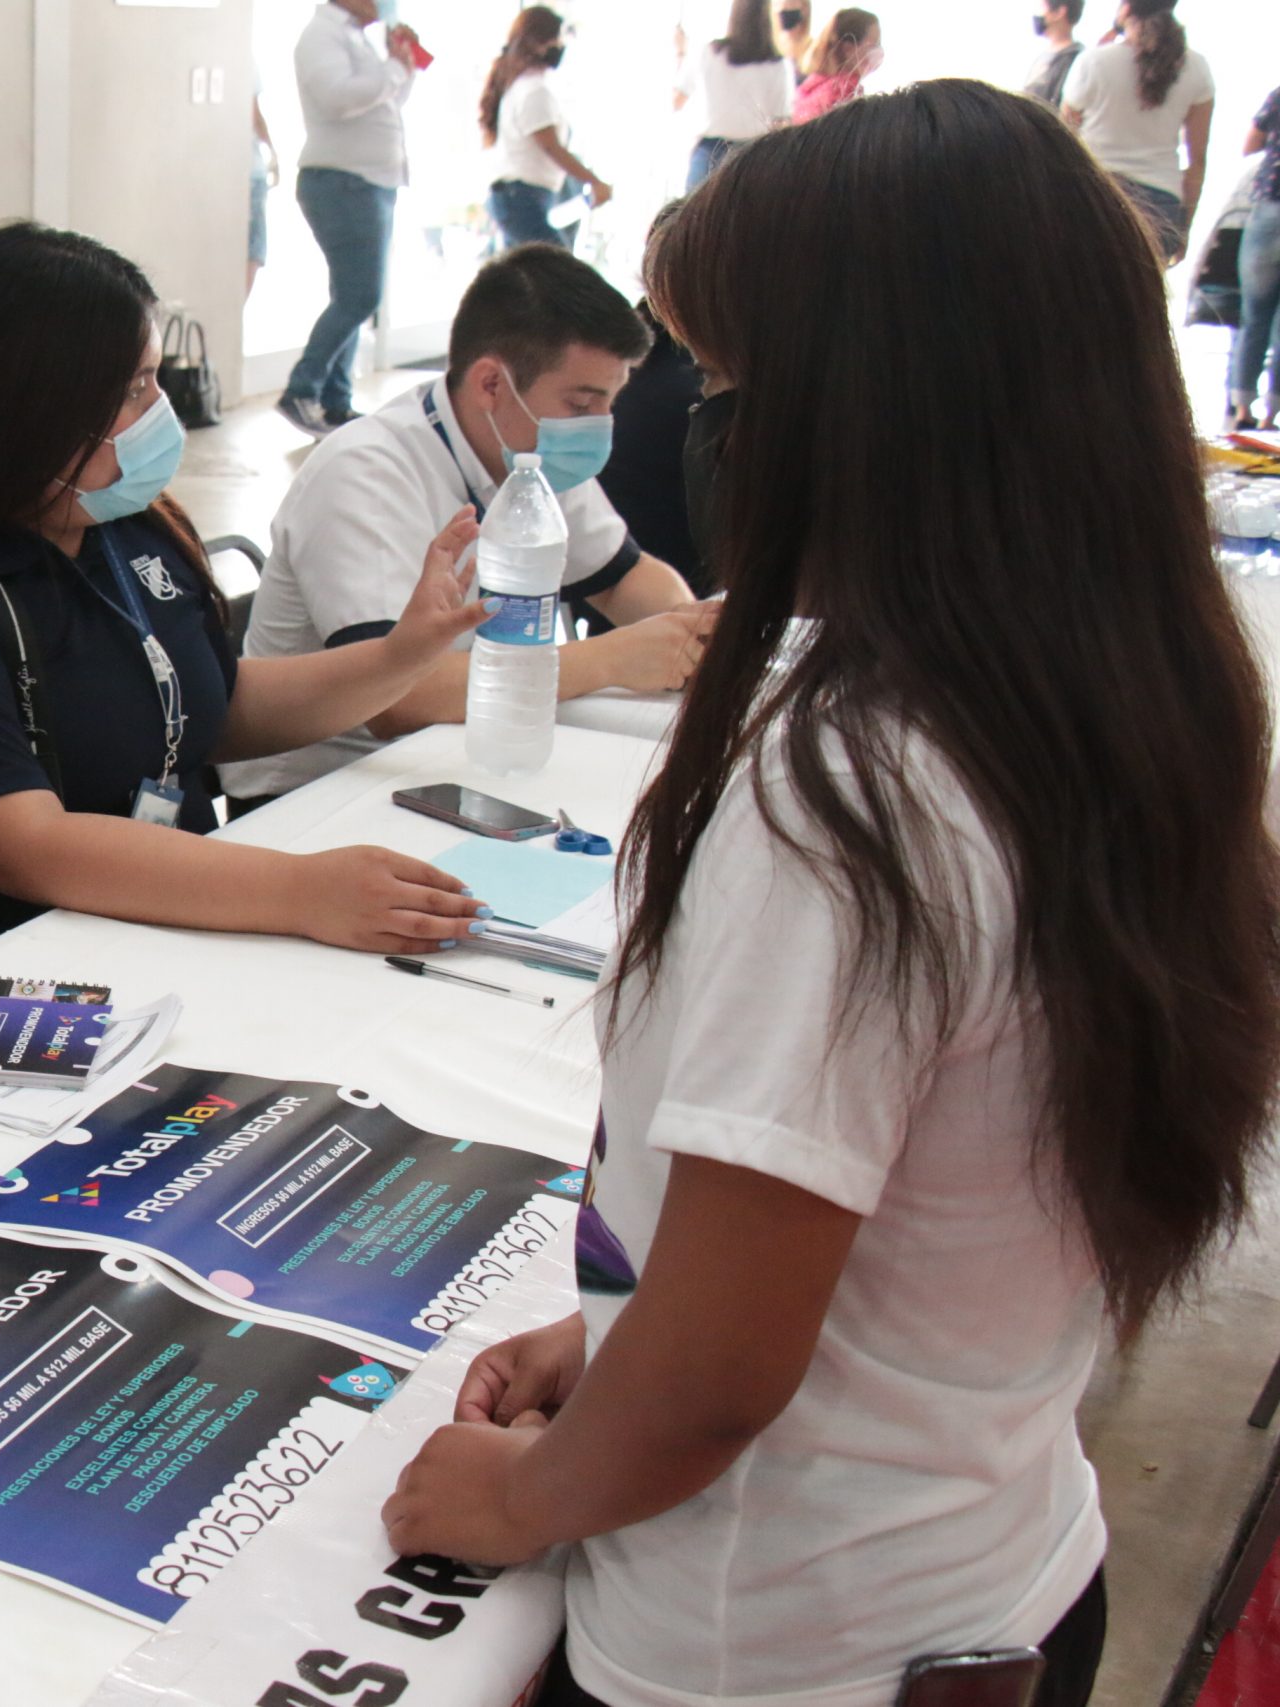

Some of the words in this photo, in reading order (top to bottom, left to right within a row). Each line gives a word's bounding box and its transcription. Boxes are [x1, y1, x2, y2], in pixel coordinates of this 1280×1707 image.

[7, 1007, 44, 1064] PROMOVENDEDOR
[41, 1025, 74, 1061] Totalplay
[87, 1094, 238, 1178] Totalplay
[328, 1137, 354, 1158] BASE
[124, 1094, 309, 1223] PROMOVENDEDOR
[303, 1164, 322, 1180] $12
[318, 1154, 335, 1169] MIL
[274, 1190, 289, 1203] $6
[284, 1180, 303, 1195] MIL
[298, 1174, 309, 1185] A
[235, 1198, 280, 1235] INGRESOS
[278, 1221, 342, 1275] PRESTACIONES
[336, 1211, 354, 1224] DE
[350, 1199, 368, 1214] LEY
[362, 1193, 373, 1202] Y
[368, 1156, 417, 1196] SUPERIORES
[352, 1204, 385, 1230] BONOS
[411, 1184, 451, 1214] CARRERA
[337, 1217, 390, 1263] EXCELENTES
[385, 1180, 432, 1219] COMISIONES
[389, 1219, 410, 1238] VIDA
[391, 1233, 441, 1278] DESCUENTO
[436, 1221, 453, 1236] DE
[446, 1188, 488, 1225] EMPLEADO
[392, 1232, 419, 1254] PAGO
[414, 1202, 453, 1234] SEMANAL
[406, 1213, 417, 1223] Y
[356, 1244, 384, 1266] PLAN
[378, 1233, 396, 1247] DE
[3, 1396, 23, 1412] $6
[16, 1382, 41, 1402] MIL
[36, 1374, 50, 1386] A
[43, 1359, 68, 1378] $12
[61, 1346, 86, 1364] MIL
[78, 1320, 112, 1349] BASE
[74, 1421, 97, 1436] DE
[90, 1402, 117, 1422] LEY
[110, 1395, 125, 1404] Y
[120, 1343, 185, 1397] SUPERIORES
[65, 1430, 138, 1490] EXCELENTES
[132, 1376, 198, 1430] COMISIONES
[86, 1468, 124, 1496] PLAN
[115, 1453, 140, 1469] DE
[130, 1432, 164, 1453] VIDA
[154, 1423, 170, 1432] Y
[164, 1381, 218, 1424] CARRERA
[92, 1409, 136, 1444] BONOS
[131, 1450, 168, 1479] PAGO
[161, 1407, 216, 1451] SEMANAL
[124, 1453, 193, 1513] DESCUENTO
[186, 1438, 209, 1454] DE
[201, 1389, 260, 1440] EMPLEADO
[153, 1430, 344, 1599] 8112523622
